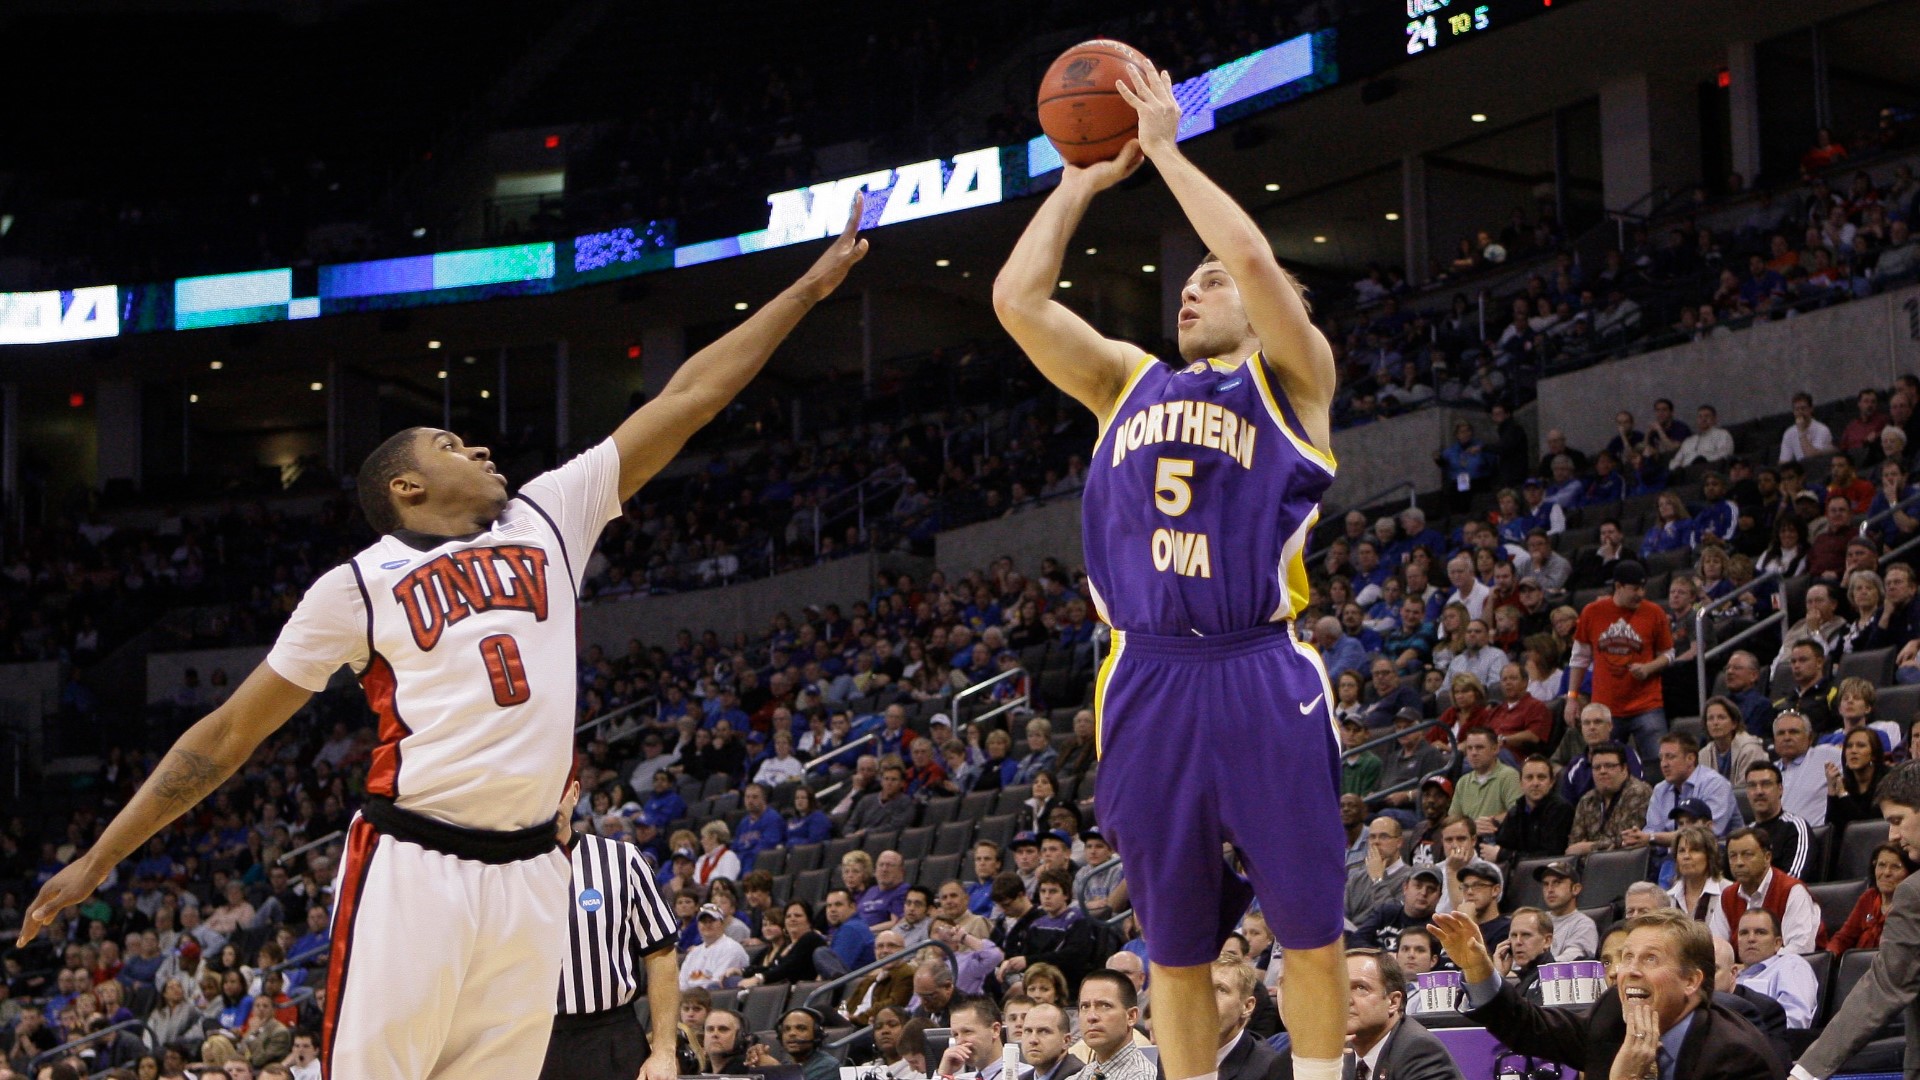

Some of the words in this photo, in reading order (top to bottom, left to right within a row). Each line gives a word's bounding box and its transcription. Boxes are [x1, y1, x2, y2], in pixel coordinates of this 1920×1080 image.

[1407, 15, 1437, 54] 24
[1475, 5, 1489, 30] 5
[767, 147, 1002, 237] NCAA
[1112, 400, 1256, 470] NORTHERN
[1155, 457, 1194, 517] 5
[392, 545, 549, 652] UNLV
[479, 633, 531, 707] 0
[582, 898, 601, 907] NCAA
